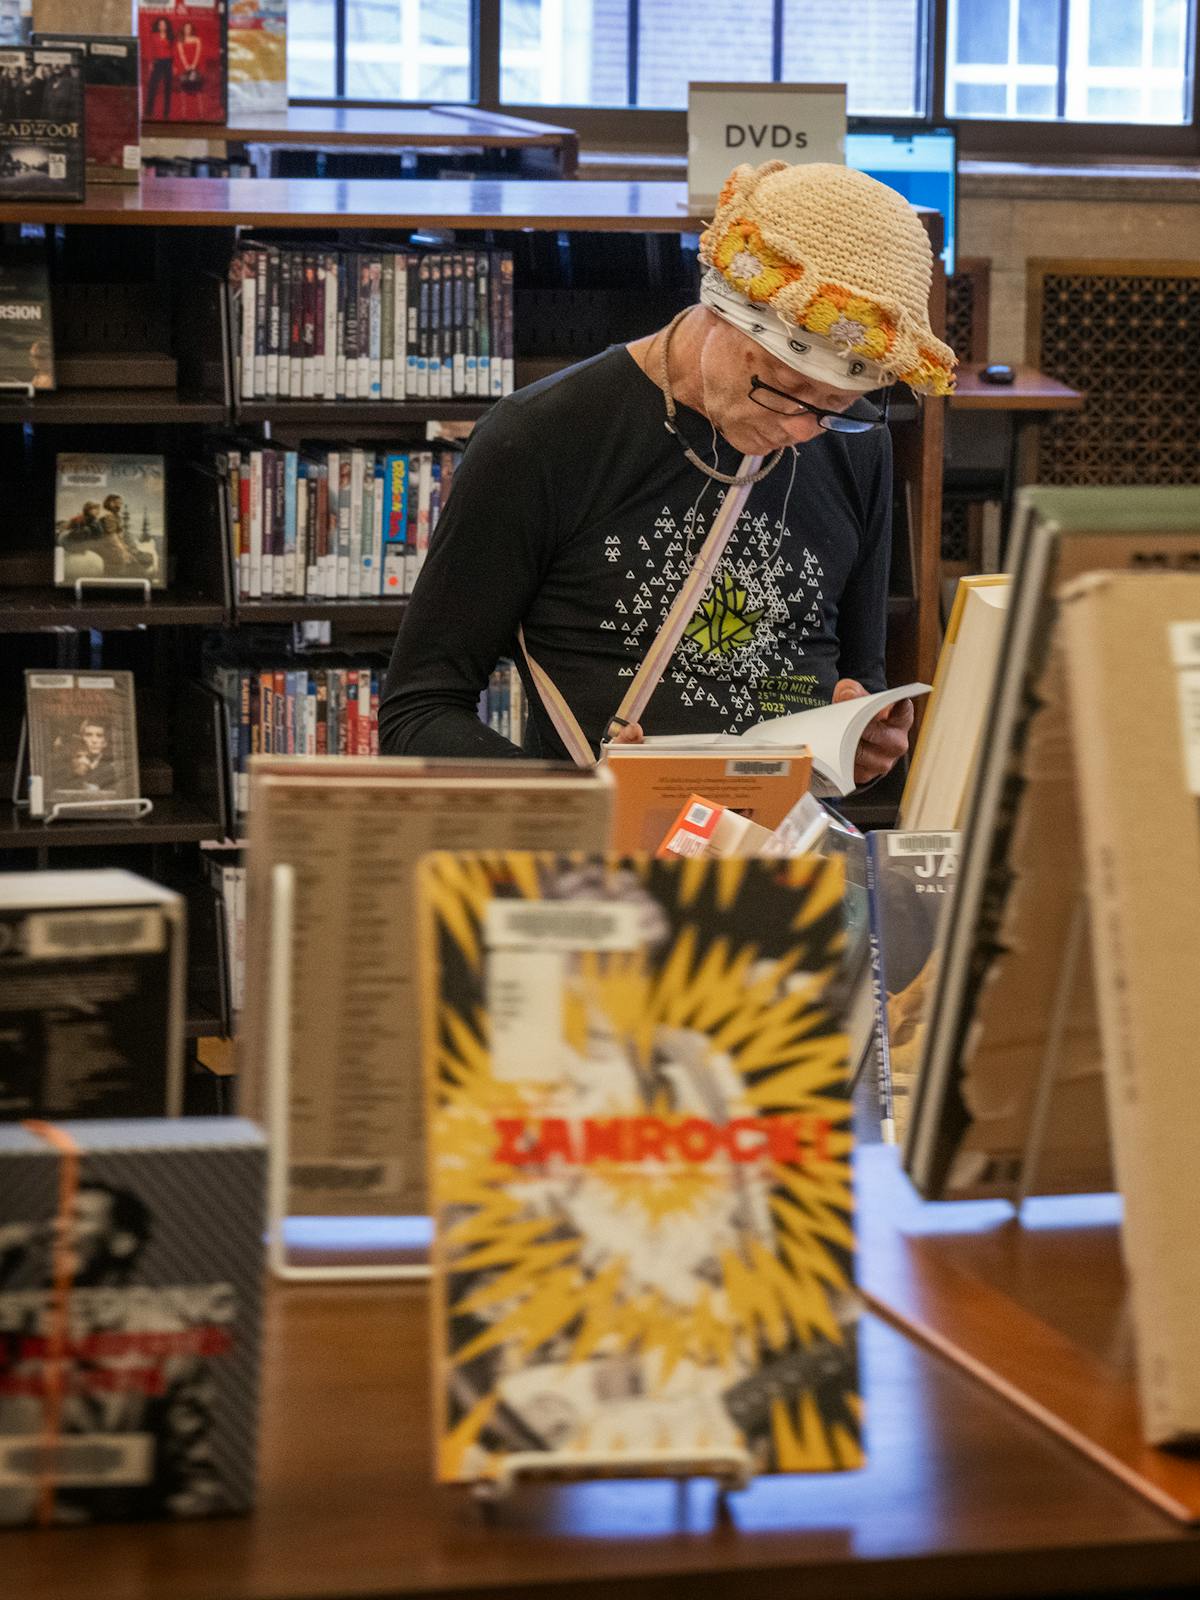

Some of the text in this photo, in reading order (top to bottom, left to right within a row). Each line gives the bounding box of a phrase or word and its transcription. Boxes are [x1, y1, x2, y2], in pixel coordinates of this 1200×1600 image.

[725, 124, 808, 148] DVDs
[761, 679, 814, 696] TC 10 MILE
[760, 701, 785, 713] 2023
[913, 850, 958, 878] JA
[493, 1115, 833, 1166] ZAMROCK!
